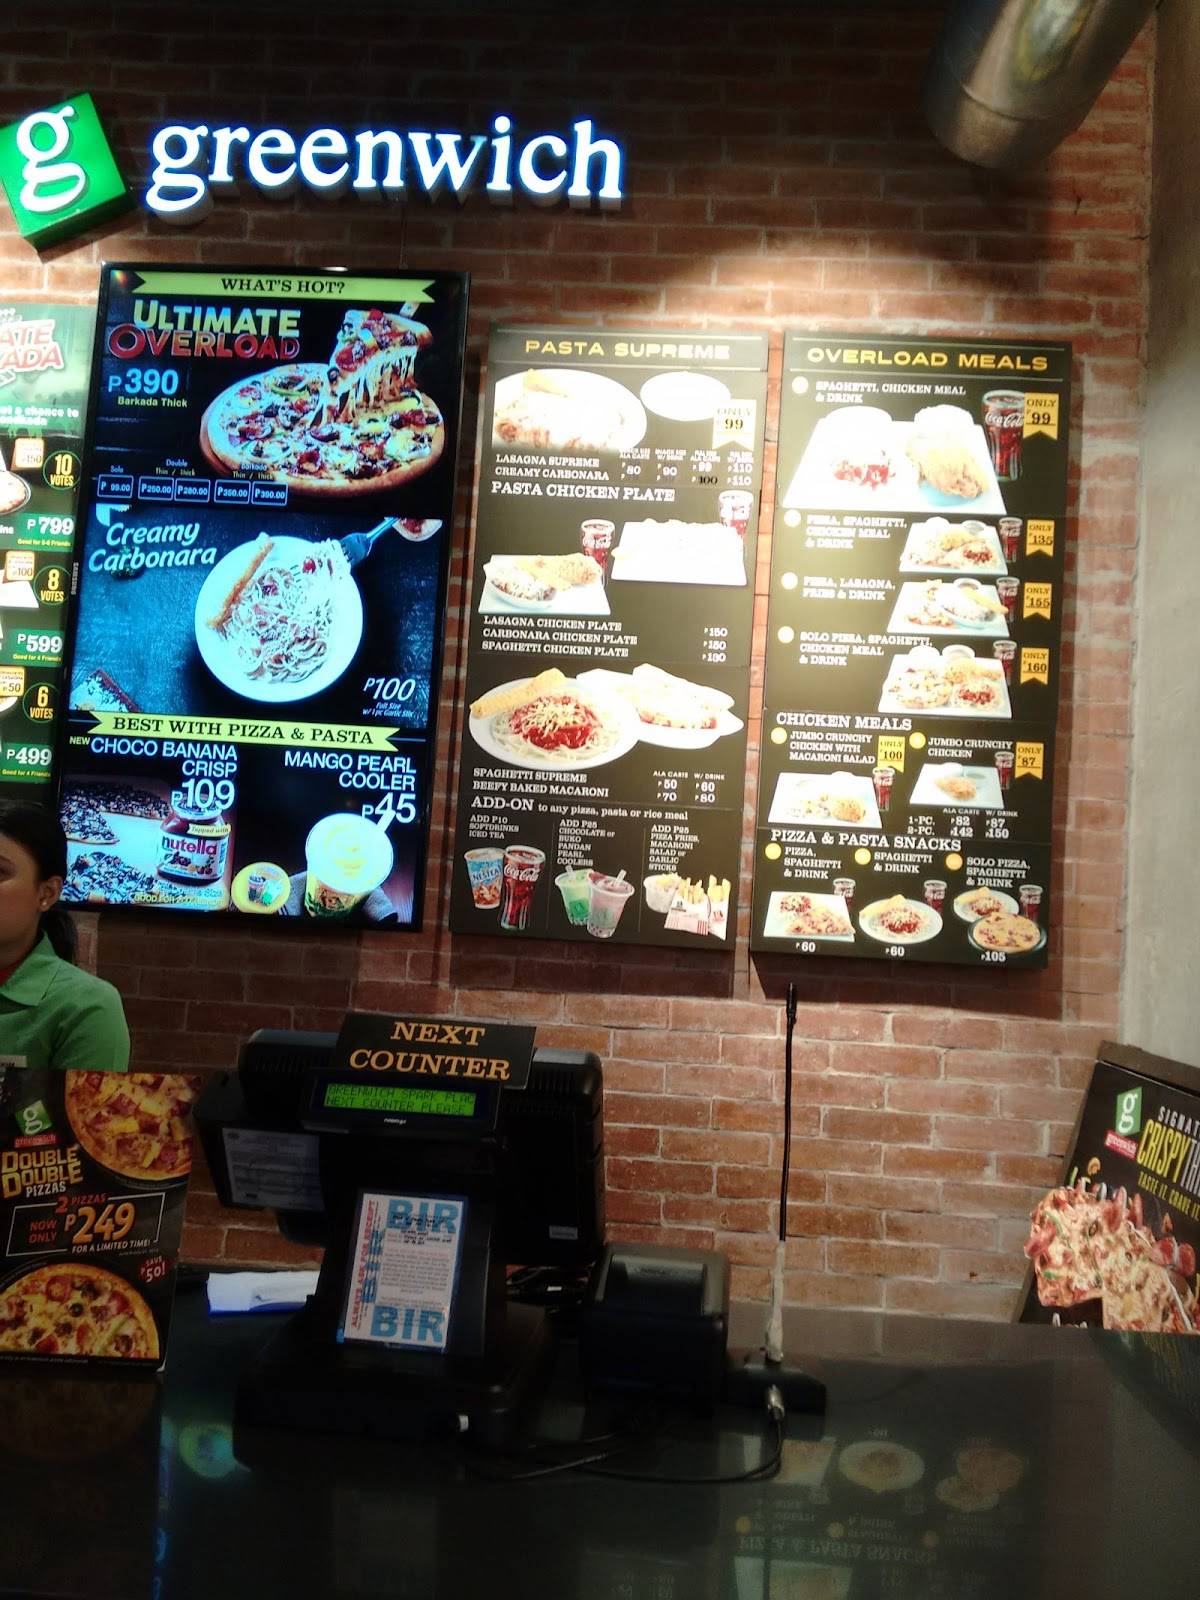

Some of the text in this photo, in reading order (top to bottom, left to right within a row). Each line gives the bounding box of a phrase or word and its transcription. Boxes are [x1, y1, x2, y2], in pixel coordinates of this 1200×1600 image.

[16, 105, 87, 214] g
[145, 116, 623, 213] greenwich
[222, 279, 345, 295] WHAT'S HOT?
[133, 300, 300, 337] ULTIMATE
[108, 323, 300, 359] OVERLOAD
[525, 340, 730, 360] PASTA SUPREME
[807, 348, 1048, 371] OVERLOAD MEALS
[881, 382, 932, 395] CHICKEN
[934, 385, 966, 396] MEAL
[117, 396, 188, 408] Barkada Thick
[826, 393, 863, 404] DRINK
[1026, 398, 1057, 408] ONLY
[55, 454, 72, 476] 10
[165, 459, 188, 468] Double
[496, 454, 600, 468] LASAGNA SUPREME
[495, 466, 610, 481] CREAMY CARBONARA
[50, 475, 74, 486] VOTES
[491, 481, 676, 502] PASTA CHICKEN PLATE
[858, 529, 891, 539] MEAL
[1028, 523, 1054, 532] ONLY
[106, 522, 200, 547] Creamy
[88, 547, 217, 572] Carbonara
[48, 568, 60, 590] 8
[40, 590, 64, 602] VOTES
[803, 588, 886, 601] FRIES DRINK
[1026, 587, 1051, 595] ONLY
[483, 616, 622, 632] LASAGNA CHICKEN PLATE
[482, 628, 638, 645] CARBONARA CHICKEN PLATE
[800, 632, 829, 642] SOLO
[482, 641, 629, 658] SPAGHETTI CHICKEN PLATE
[800, 643, 884, 656] CHICKEN MEAL
[809, 656, 847, 666] DRINK
[37, 686, 49, 708] 6
[29, 707, 54, 720] VOTES
[776, 713, 913, 731] CHICKEN MEALS
[113, 717, 374, 745] BEST WITH PIZZA & PASTA
[790, 731, 873, 744] JUMBO CRUNCHY
[69, 736, 238, 761] NEW CHOCO BANANA
[790, 741, 861, 754] CHICKEN WITH
[928, 737, 1013, 751] JUMBO CRUNCHY
[789, 752, 876, 765] MACARONI SALAD
[927, 748, 973, 758] CHICKEN
[182, 760, 237, 777] CRISP
[284, 751, 416, 774] MANGO PEARL
[339, 772, 415, 791] COOLER
[473, 768, 587, 784] SPAGHETTI SUPREME
[472, 780, 609, 798] BEEFY BAKED MACARONI
[471, 796, 688, 820] ADD-ON to any pizza, pasta or rice meal
[470, 815, 490, 824] ADD
[559, 819, 580, 828] ADD
[908, 816, 936, 826] 1-PC.
[469, 823, 520, 833] SOFTDRINKS
[558, 828, 606, 838] CHOCOLATE
[651, 824, 672, 833] ADD
[907, 826, 936, 837] 2-PC.
[469, 830, 505, 840] ICED TEA
[558, 835, 582, 844] BUKO
[651, 833, 673, 842] PIZZA
[771, 830, 962, 852] PIZZA & PASTA SNACKS
[161, 836, 218, 856] nutella
[558, 842, 592, 851] PANDAN
[650, 840, 694, 850] MACARONI
[557, 850, 585, 859] PEARL
[649, 848, 676, 857] SALAD
[874, 852, 933, 863] SPAGHETTI
[557, 857, 594, 867] COOLERS
[649, 856, 679, 865] GARLIC
[783, 858, 842, 870] SPAGHETTI
[966, 857, 996, 868] SOLO
[648, 863, 677, 872] STICKS
[884, 863, 920, 874] DRINK
[966, 867, 1027, 879] SPAGHETTI
[794, 869, 829, 880] DRINK
[976, 878, 1013, 888] DRINK
[390, 1021, 485, 1047] NEXT
[350, 1049, 510, 1081] COUNTER
[362, 1098, 417, 1112] COUNTER
[1118, 1093, 1138, 1134] g
[1106, 1133, 1137, 1155] greenwich
[1, 1143, 80, 1174] DOUBLE
[1, 1160, 84, 1199] DOUBLE
[26, 1181, 67, 1198] PIZZAS
[1138, 1171, 1191, 1216] TASTE CRAVE
[55, 1192, 108, 1214] 2 PIZZAS
[386, 1199, 459, 1234] BIR
[29, 1219, 57, 1231] NOW
[28, 1232, 57, 1245] ONLY
[72, 1239, 151, 1254] FOR A LIMITED TIME!
[370, 1306, 446, 1342] BIR
